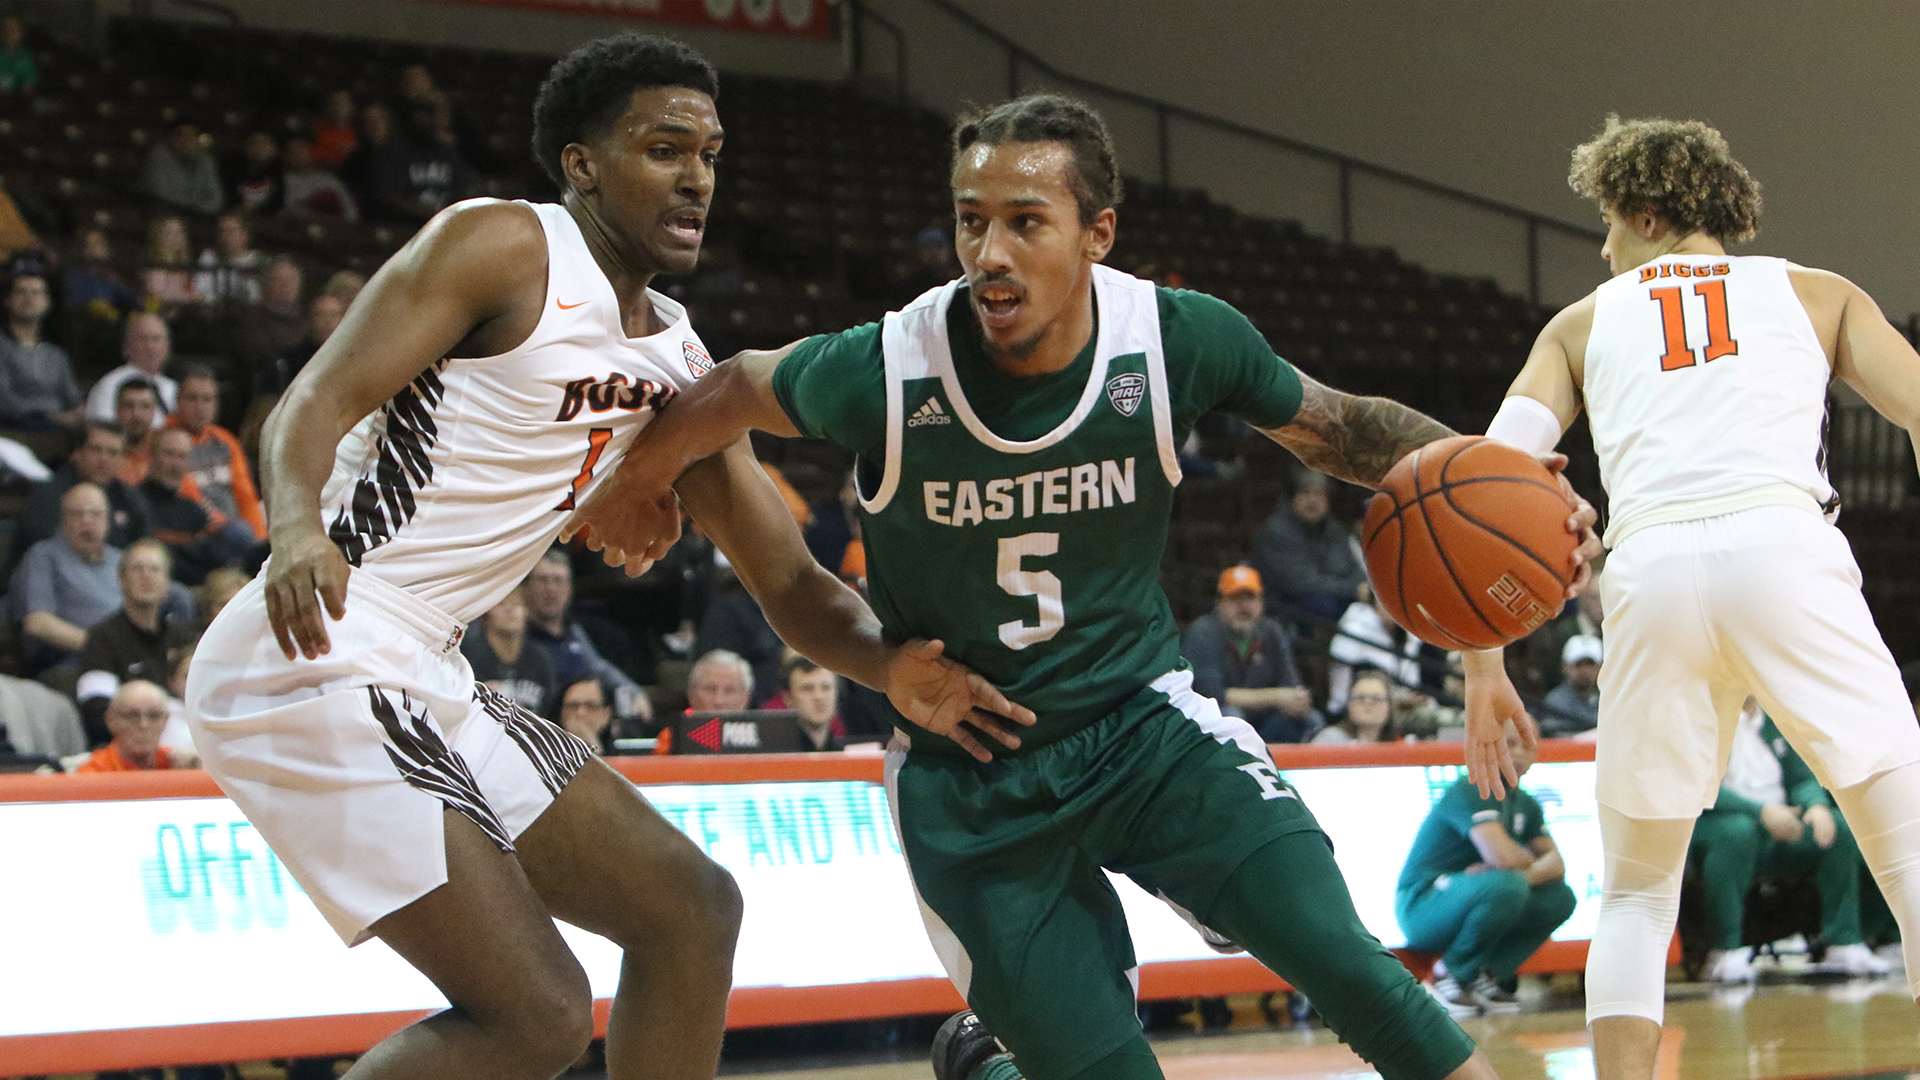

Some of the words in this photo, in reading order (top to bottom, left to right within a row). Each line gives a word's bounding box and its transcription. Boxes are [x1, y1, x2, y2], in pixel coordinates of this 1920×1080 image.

[1639, 262, 1730, 284] DIGGS
[1649, 279, 1738, 371] 11
[685, 349, 711, 370] MAC
[1111, 385, 1142, 400] MAC
[907, 413, 951, 427] adidas
[553, 427, 613, 511] 1
[923, 457, 1136, 527] EASTERN
[997, 532, 1065, 650] 5
[1236, 762, 1297, 800] E
[157, 822, 303, 898] OFFI
[745, 797, 832, 866] AND
